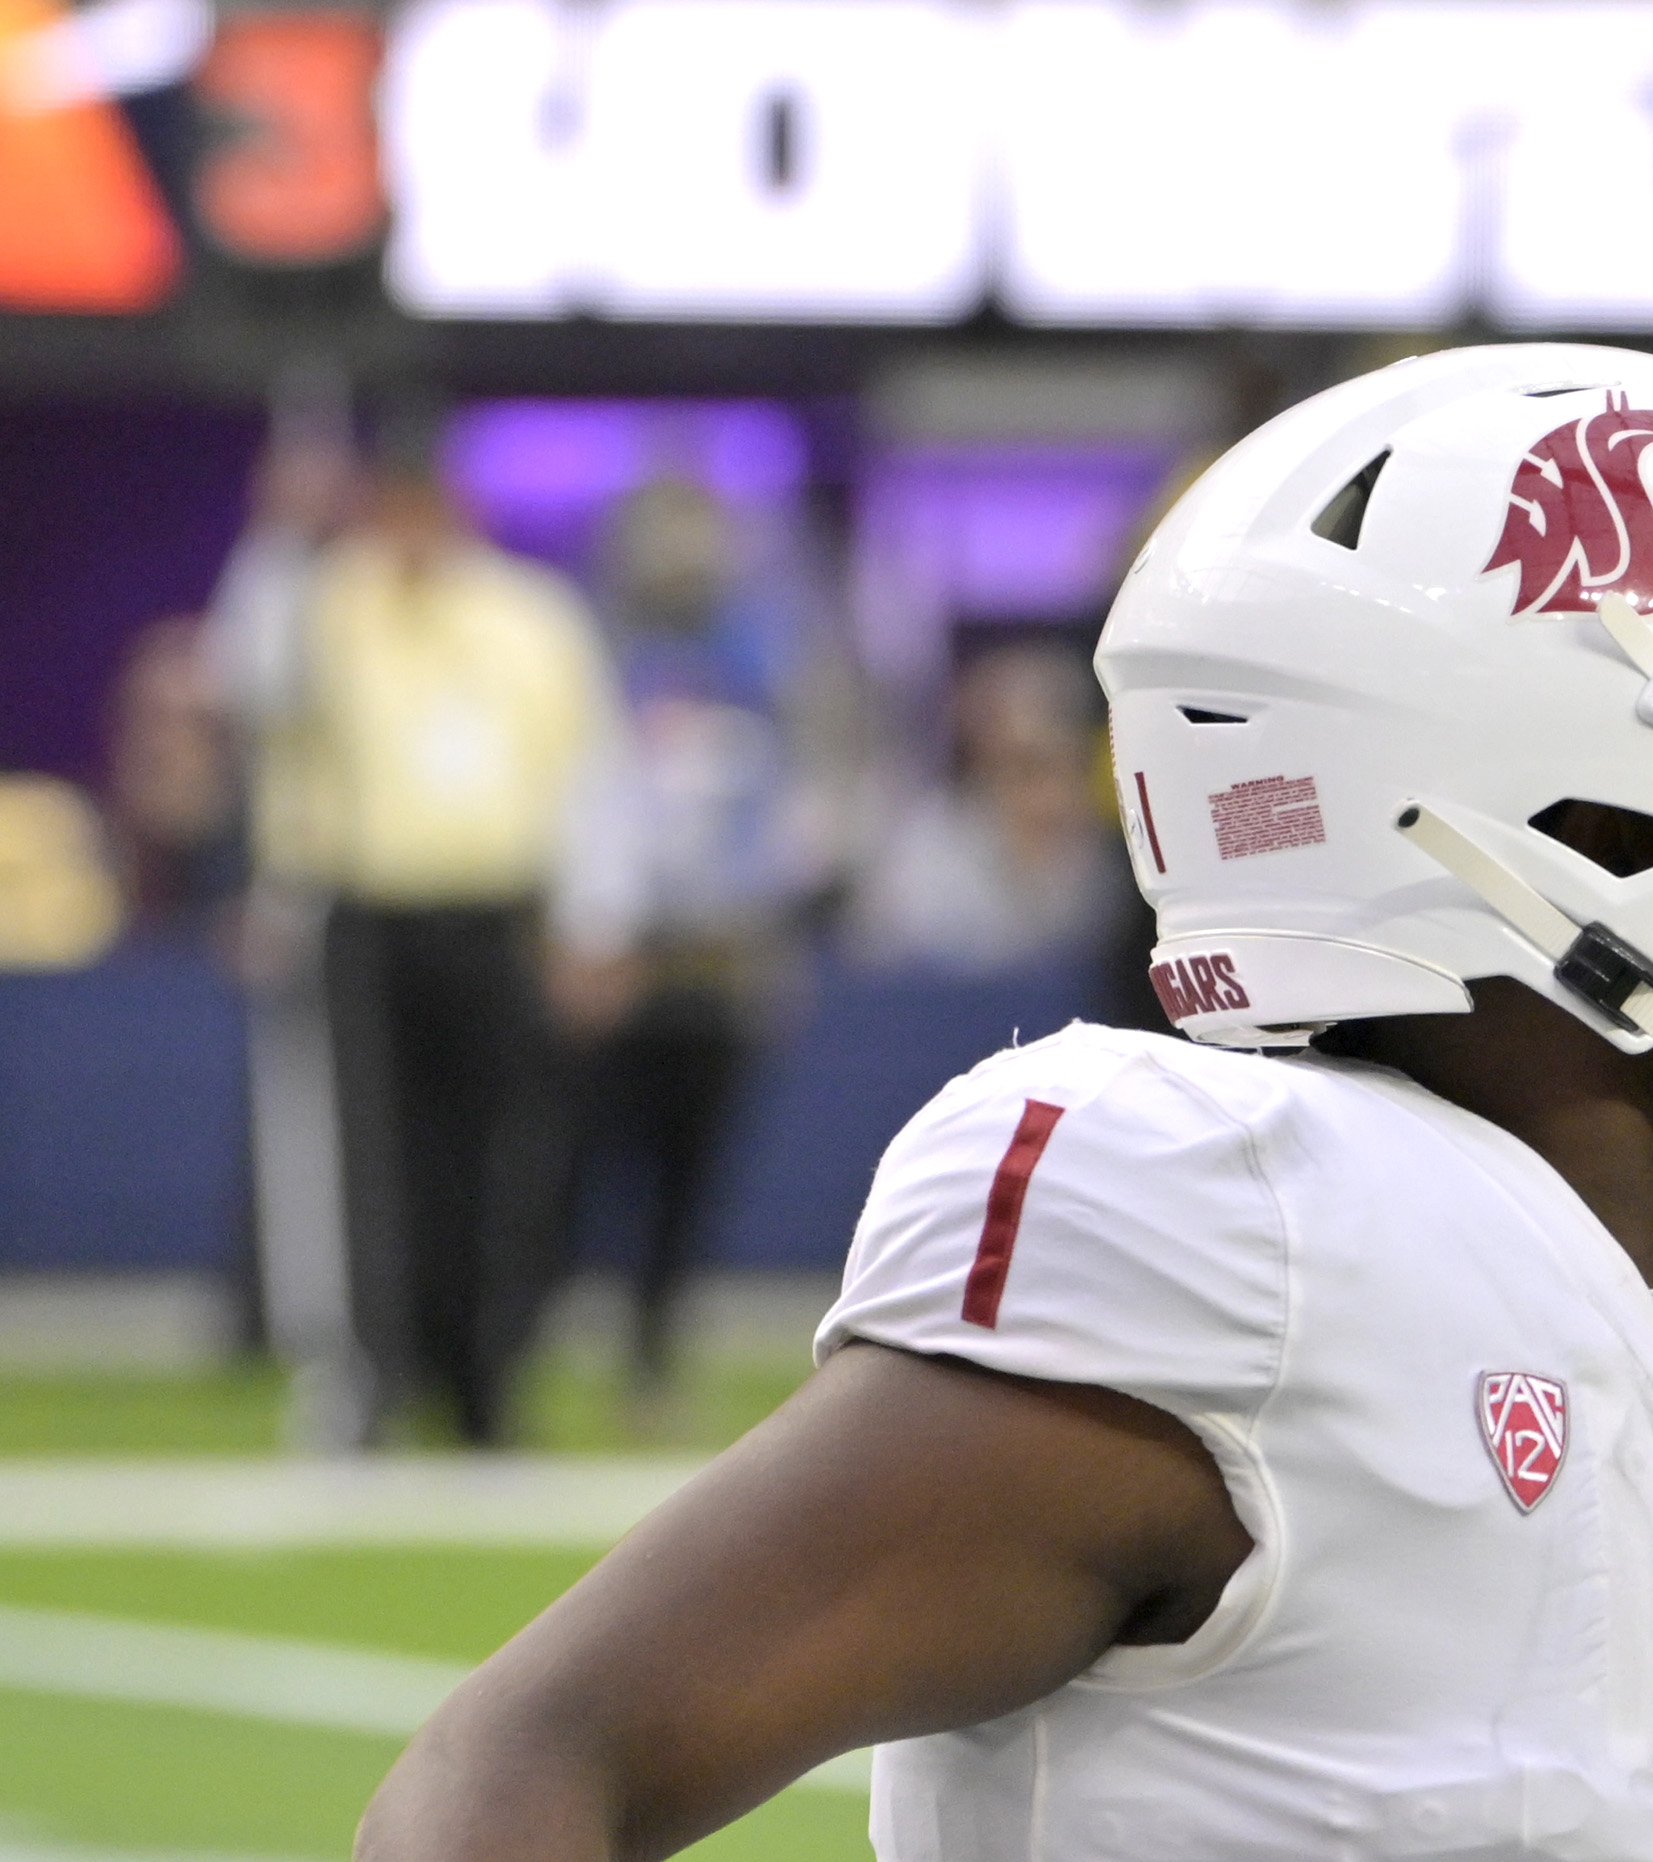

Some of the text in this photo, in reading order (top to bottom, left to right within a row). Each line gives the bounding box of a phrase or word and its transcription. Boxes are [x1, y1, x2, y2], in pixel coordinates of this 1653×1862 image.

[1231, 775, 1284, 790] WARNING
[961, 1098, 1066, 1331] 1
[1505, 1429, 1549, 1483] 12
